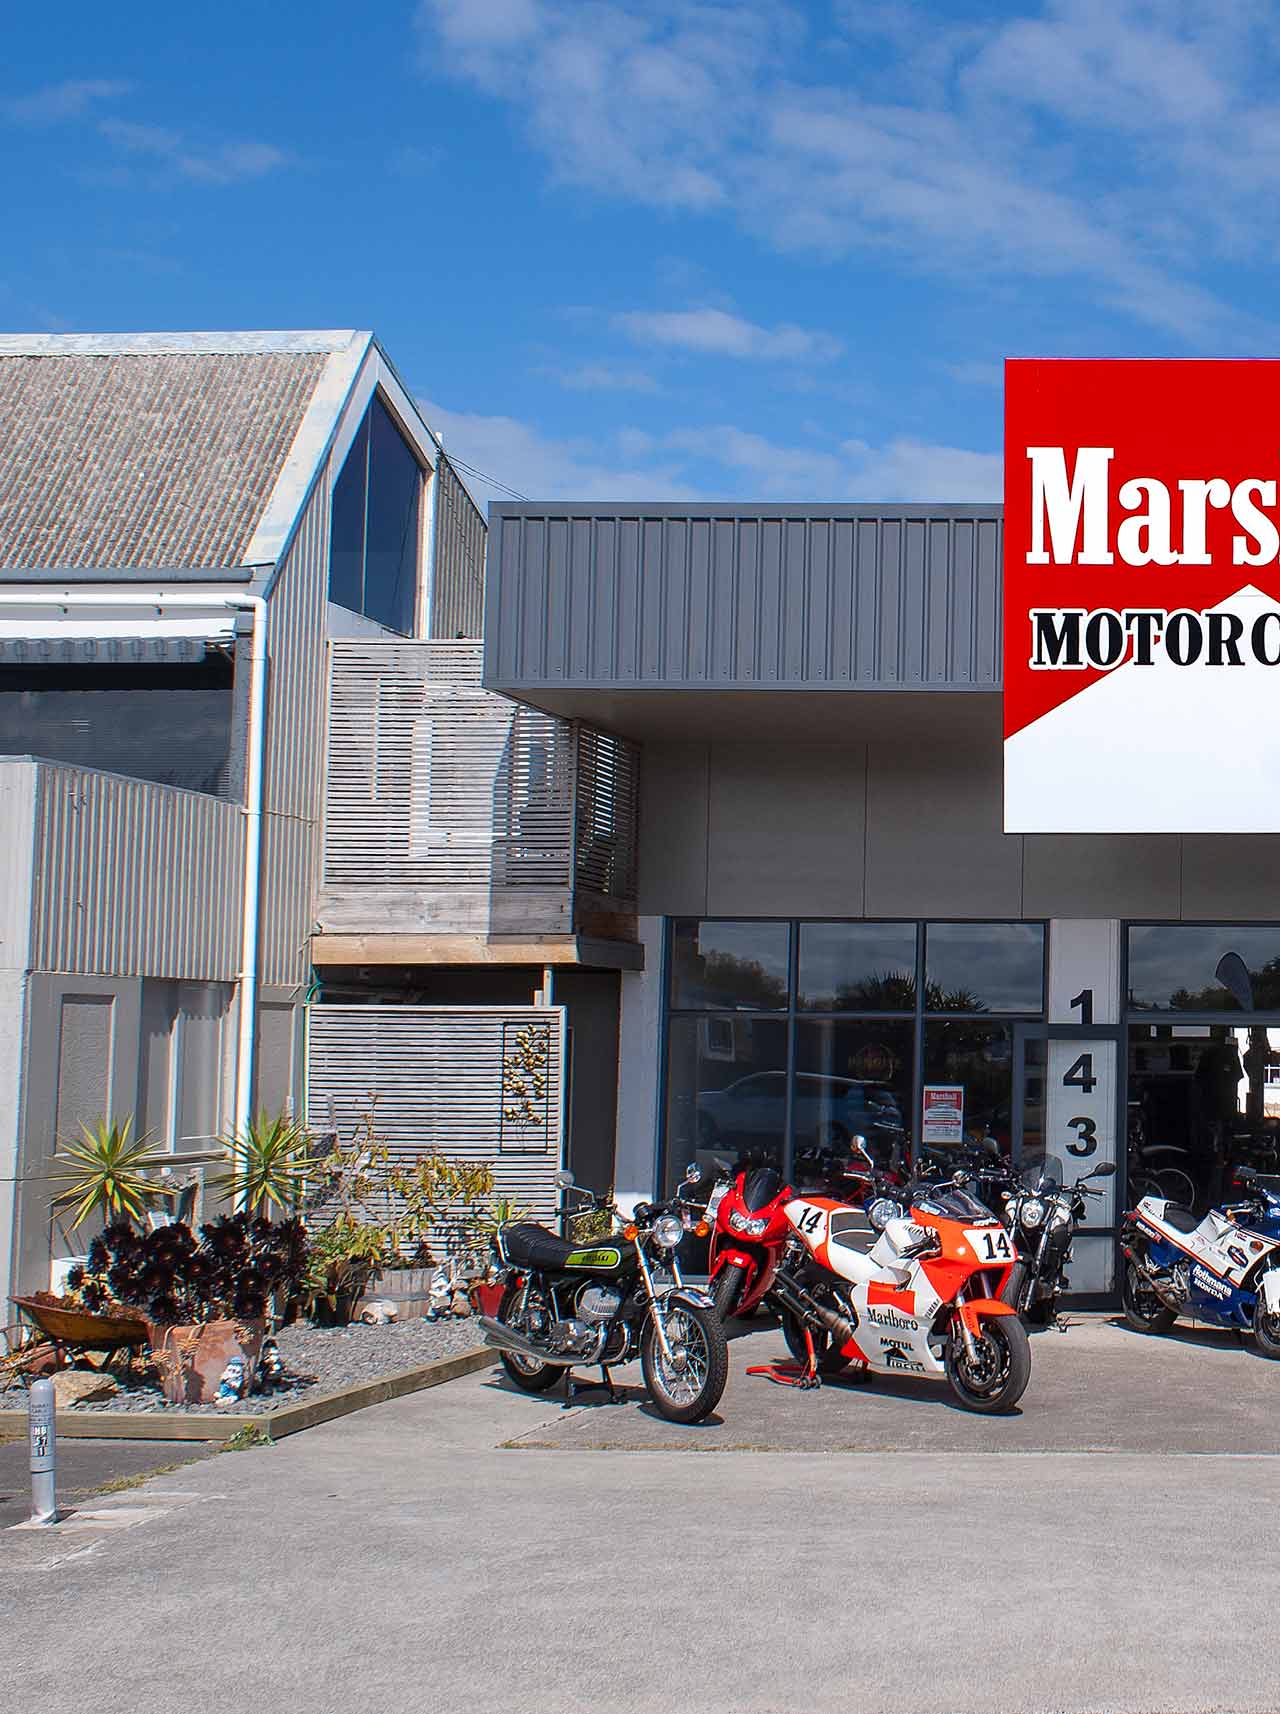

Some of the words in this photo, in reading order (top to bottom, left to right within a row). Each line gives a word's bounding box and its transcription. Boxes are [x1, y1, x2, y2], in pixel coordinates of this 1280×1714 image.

[796, 1206, 824, 1234] 14
[982, 1232, 1012, 1260] 14
[1192, 1264, 1232, 1298] Rothmans
[1193, 1278, 1225, 1302] HONDA
[866, 1306, 921, 1332] Marlboro
[880, 1336, 915, 1352] MOTUL
